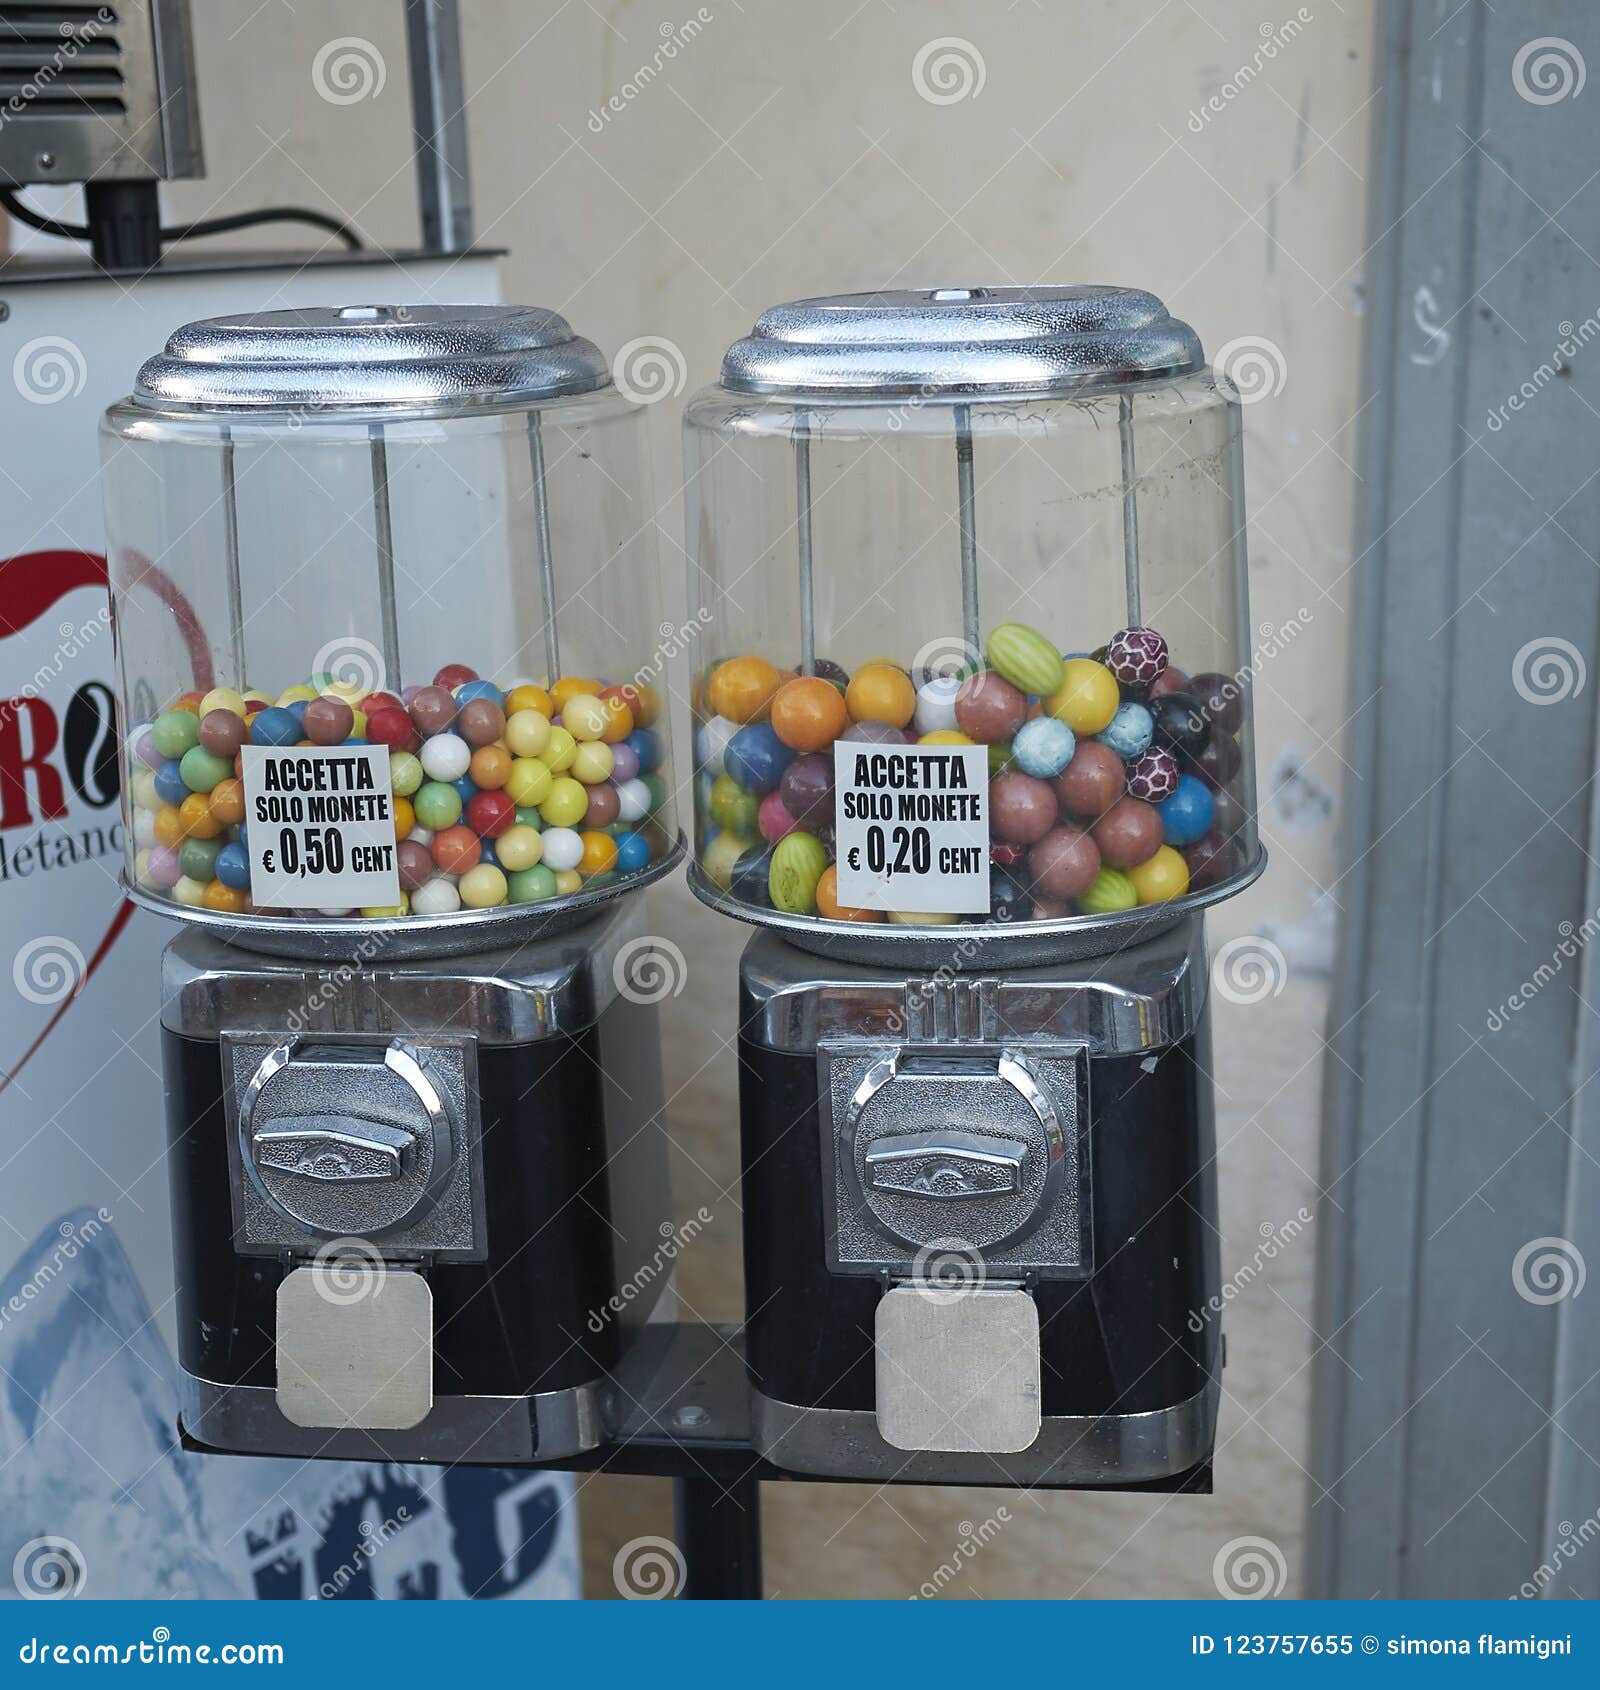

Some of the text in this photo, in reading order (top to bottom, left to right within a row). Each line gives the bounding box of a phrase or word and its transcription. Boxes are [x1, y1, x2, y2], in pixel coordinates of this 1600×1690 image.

[265, 757, 374, 791] ACCETTA
[854, 754, 968, 789] ACCETTA
[256, 794, 389, 823] SOLO MONETE
[843, 792, 981, 821] SOLO MONETE
[262, 827, 393, 878] € 0,50 CENT
[847, 825, 981, 878] € 0,20 CENT
